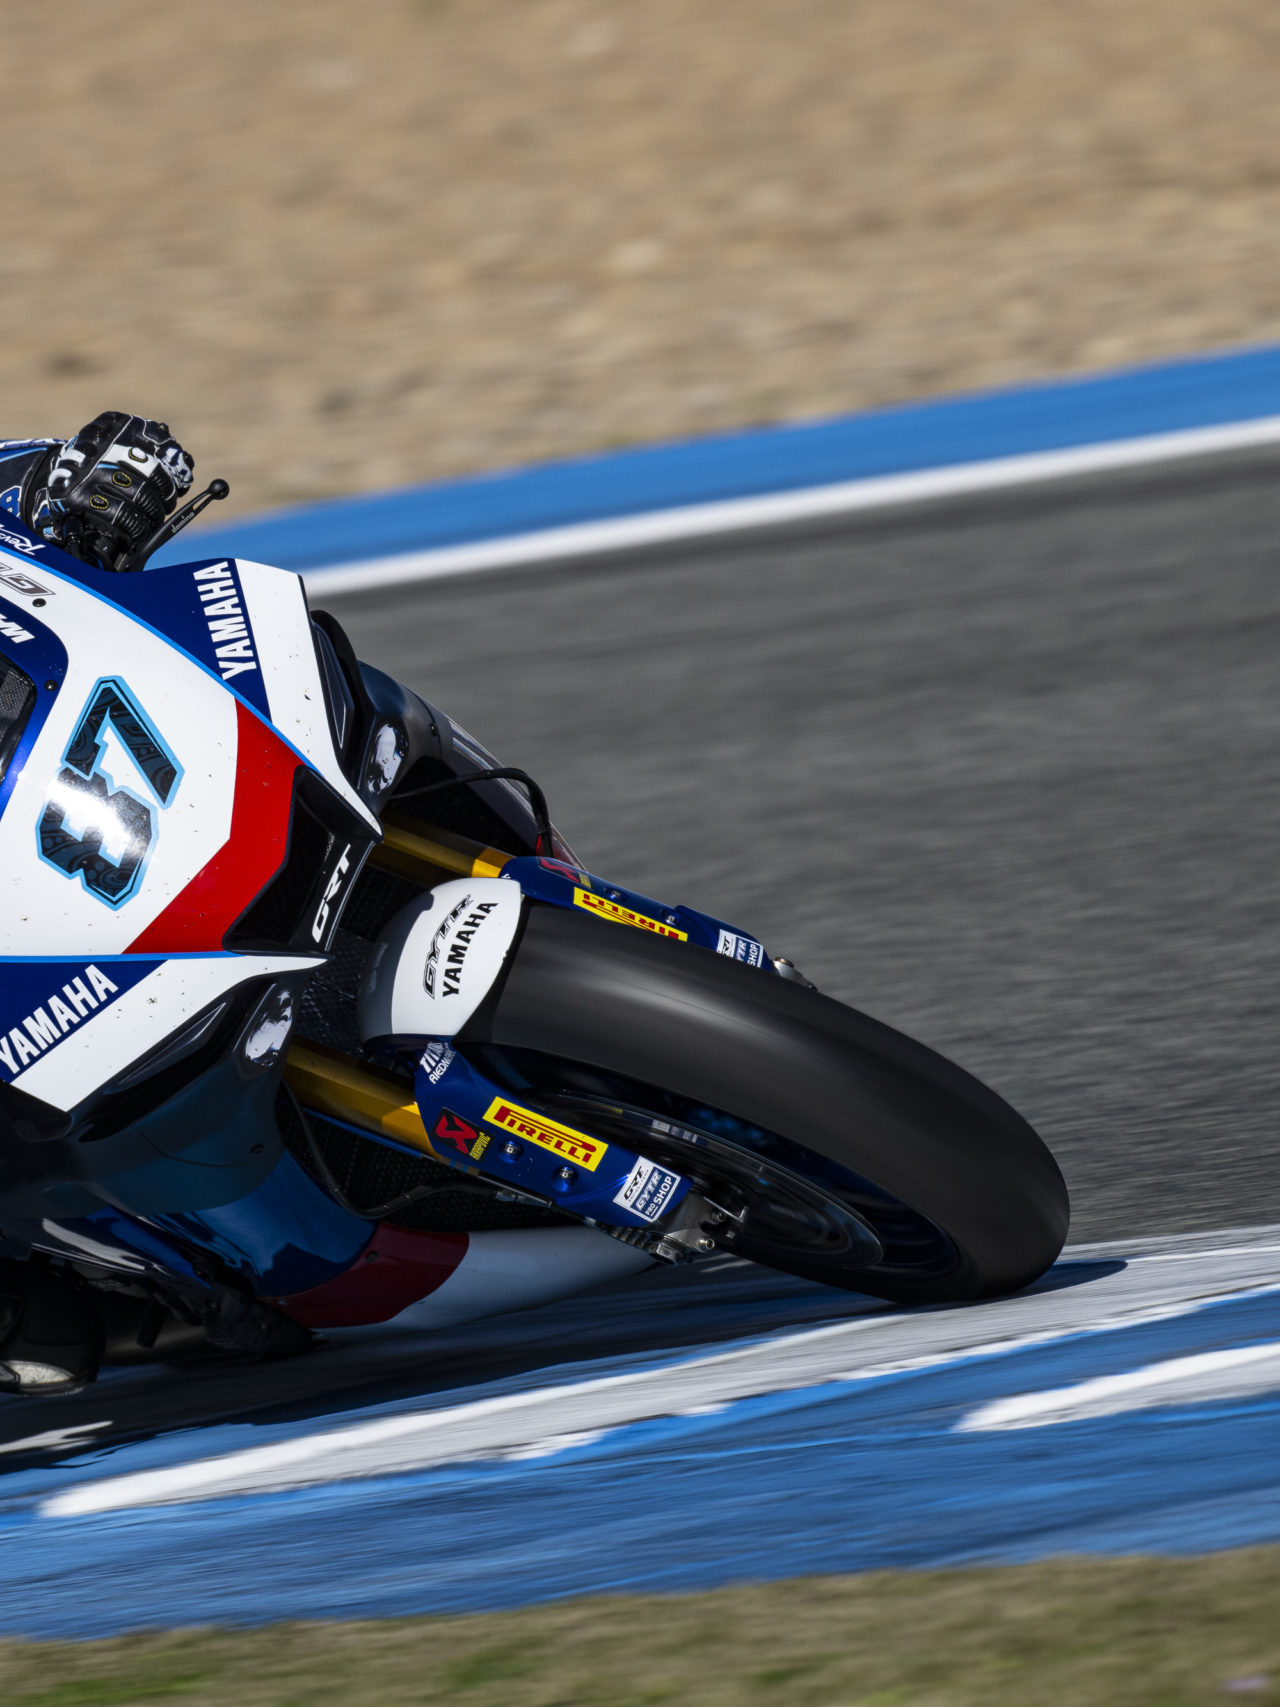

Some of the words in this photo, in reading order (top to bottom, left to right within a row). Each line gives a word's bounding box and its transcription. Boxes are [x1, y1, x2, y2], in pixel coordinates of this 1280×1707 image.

[193, 561, 257, 680] YAMAHA
[311, 843, 352, 943] GRT
[423, 893, 473, 999] GYTR
[442, 903, 498, 998] YAMAHA
[493, 1105, 597, 1164] PIRELLI
[622, 1166, 643, 1200] GRT
[636, 1171, 662, 1211] GYTR
[644, 1203, 656, 1217] PRO
[654, 1176, 673, 1206] SHOP
